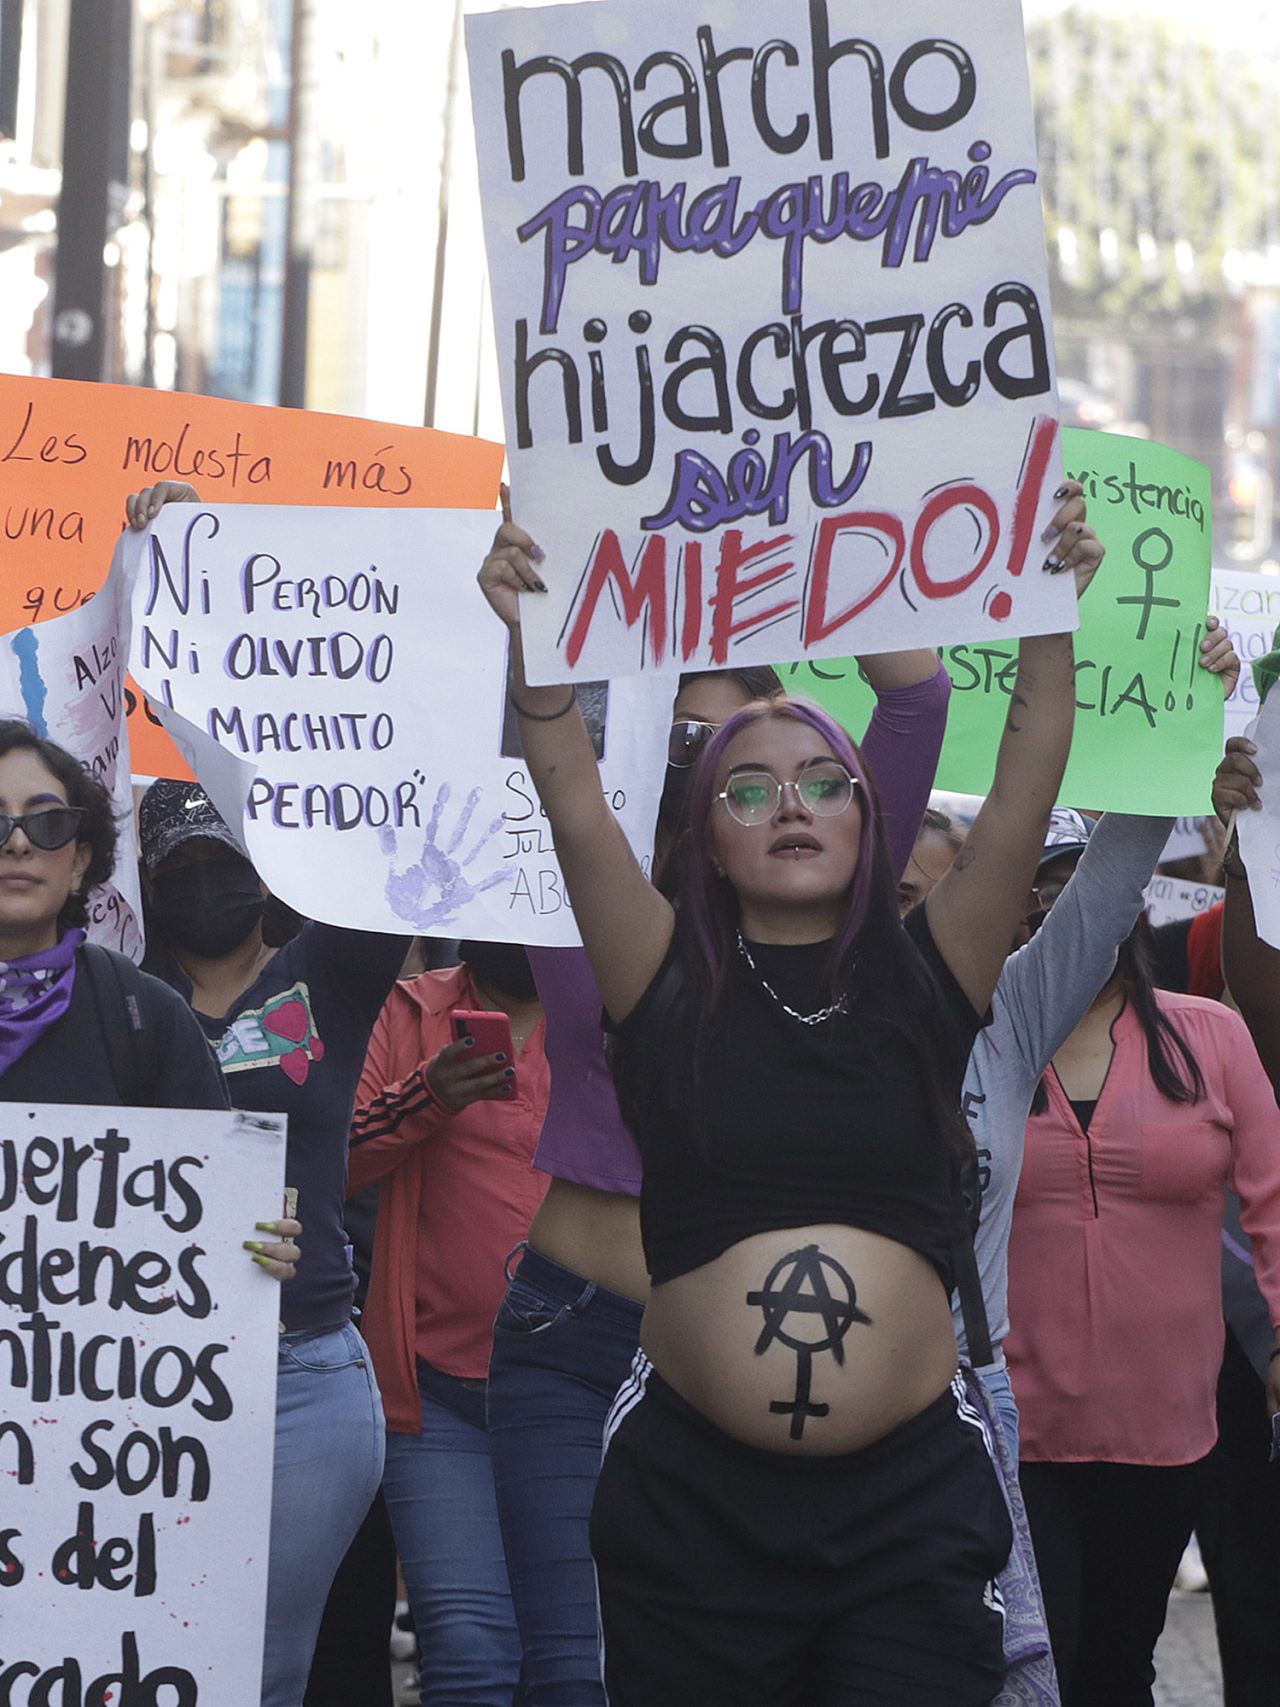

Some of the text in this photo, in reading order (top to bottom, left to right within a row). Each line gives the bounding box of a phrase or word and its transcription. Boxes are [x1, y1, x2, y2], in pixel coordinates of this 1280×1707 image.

[501, 0, 976, 181] marcho
[1, 401, 414, 496] Les molesta más
[641, 429, 872, 533] sin
[5, 506, 85, 543] una
[557, 415, 1060, 670] MIEDO!
[224, 632, 395, 684] OLVIDO
[207, 707, 396, 754] MACHITO
[70, 1419, 211, 1502] son
[51, 1501, 157, 1598] del
